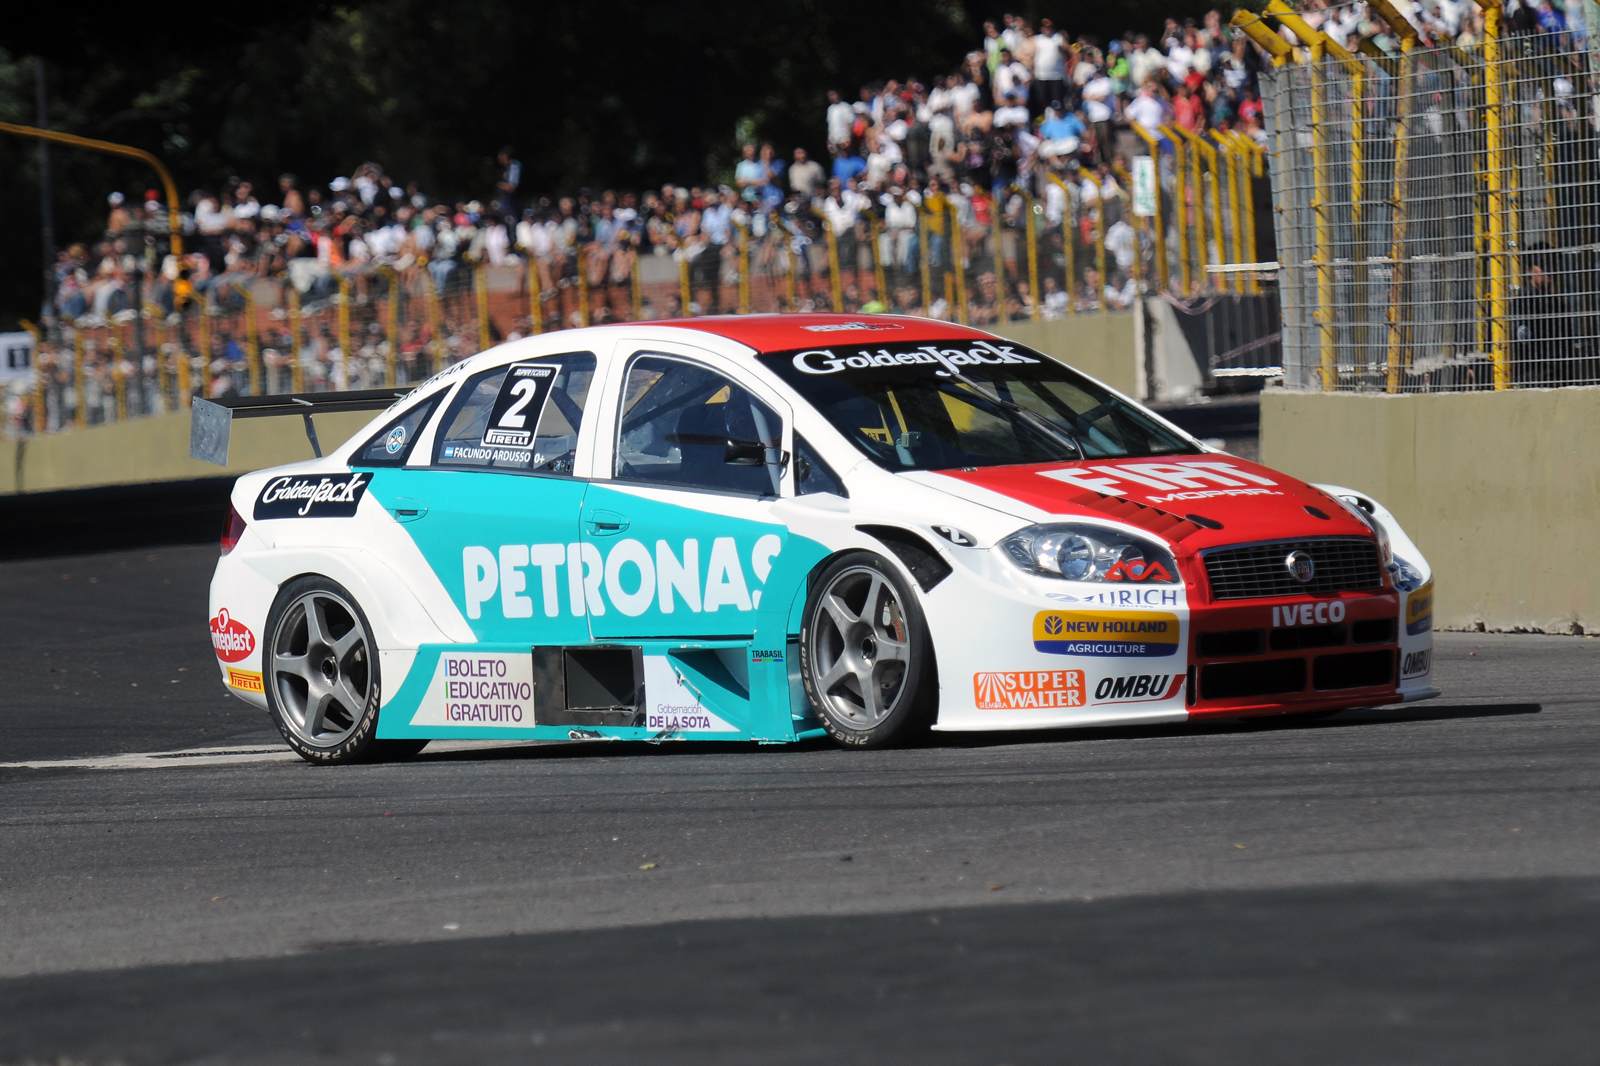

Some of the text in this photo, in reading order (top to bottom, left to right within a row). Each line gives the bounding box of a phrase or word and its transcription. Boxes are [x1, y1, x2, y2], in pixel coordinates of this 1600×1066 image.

[498, 378, 537, 428] 2
[485, 428, 531, 445] PIRELLI
[454, 447, 492, 460] FACUNDO
[492, 450, 531, 462] ARDUSSO
[1035, 462, 1278, 496] FIAT
[1146, 488, 1271, 503] MOPAR
[941, 526, 969, 544] 2
[463, 534, 781, 620] PETRONAS
[1104, 559, 1173, 581] ACA
[1272, 601, 1346, 628] IVECO
[1066, 621, 1168, 633] NEW HOLLAND
[210, 625, 252, 656] inteplast
[1067, 643, 1146, 654] AGRICULTURE
[751, 650, 784, 658] TRABASIL
[1402, 649, 1429, 676] OMBU
[448, 659, 507, 678] BOLETO
[230, 671, 262, 690] PIRELLI
[1005, 671, 1080, 690] SUPER
[1095, 674, 1170, 700] OMBU
[449, 681, 531, 700] EDUCATIVO
[1006, 689, 1081, 708] WALTER
[346, 683, 380, 752] PIRELLI
[450, 703, 523, 722] GRATUITO
[657, 703, 702, 715] Gobernación
[649, 715, 711, 729] DE LA SOTA
[817, 712, 870, 745] PIRELLI
